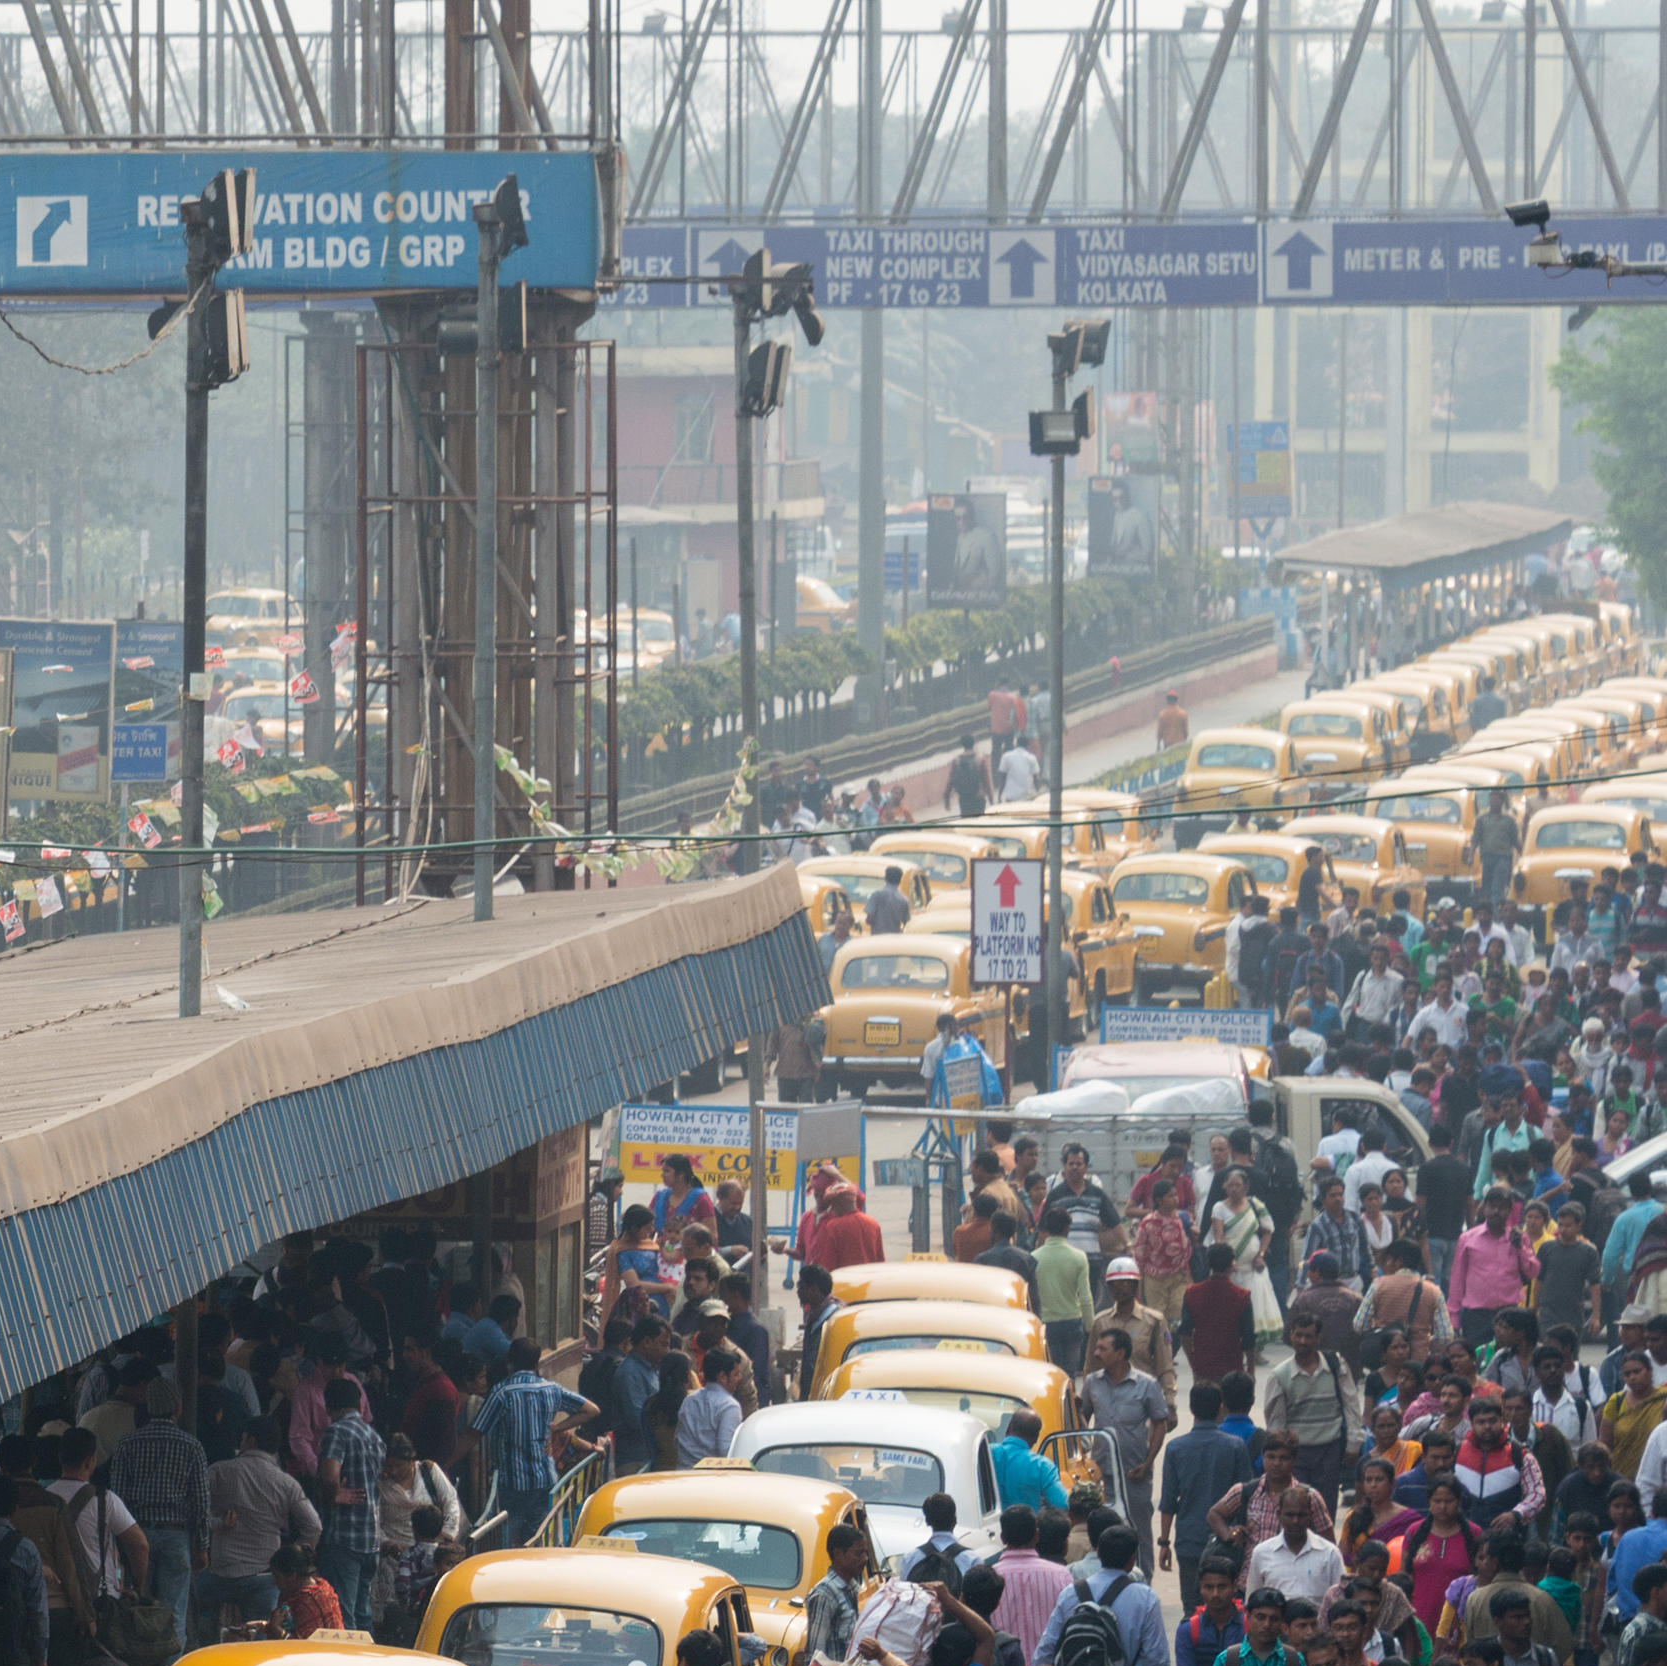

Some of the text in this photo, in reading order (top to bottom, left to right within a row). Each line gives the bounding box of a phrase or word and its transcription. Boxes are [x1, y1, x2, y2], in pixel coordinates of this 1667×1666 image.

[377, 190, 531, 225] COUNTR
[284, 234, 465, 268] BLDG GRP
[825, 231, 984, 253] TAXI THROUGH
[1077, 229, 1124, 251] TAXI
[825, 257, 982, 280] NEW COMPLEX
[1077, 251, 1255, 278] VIDYASAGAR SETU
[1344, 246, 1500, 272] METER PRE
[827, 282, 962, 305] PF 17 23
[1077, 280, 1167, 303] KOLKATA
[990, 911, 1026, 933] WAY TO
[974, 935, 1025, 956] PLATFORM
[987, 960, 1028, 979] 17 TO 23
[626, 1109, 733, 1125] HOWRAH CITY
[851, 1391, 897, 1401] TAXI
